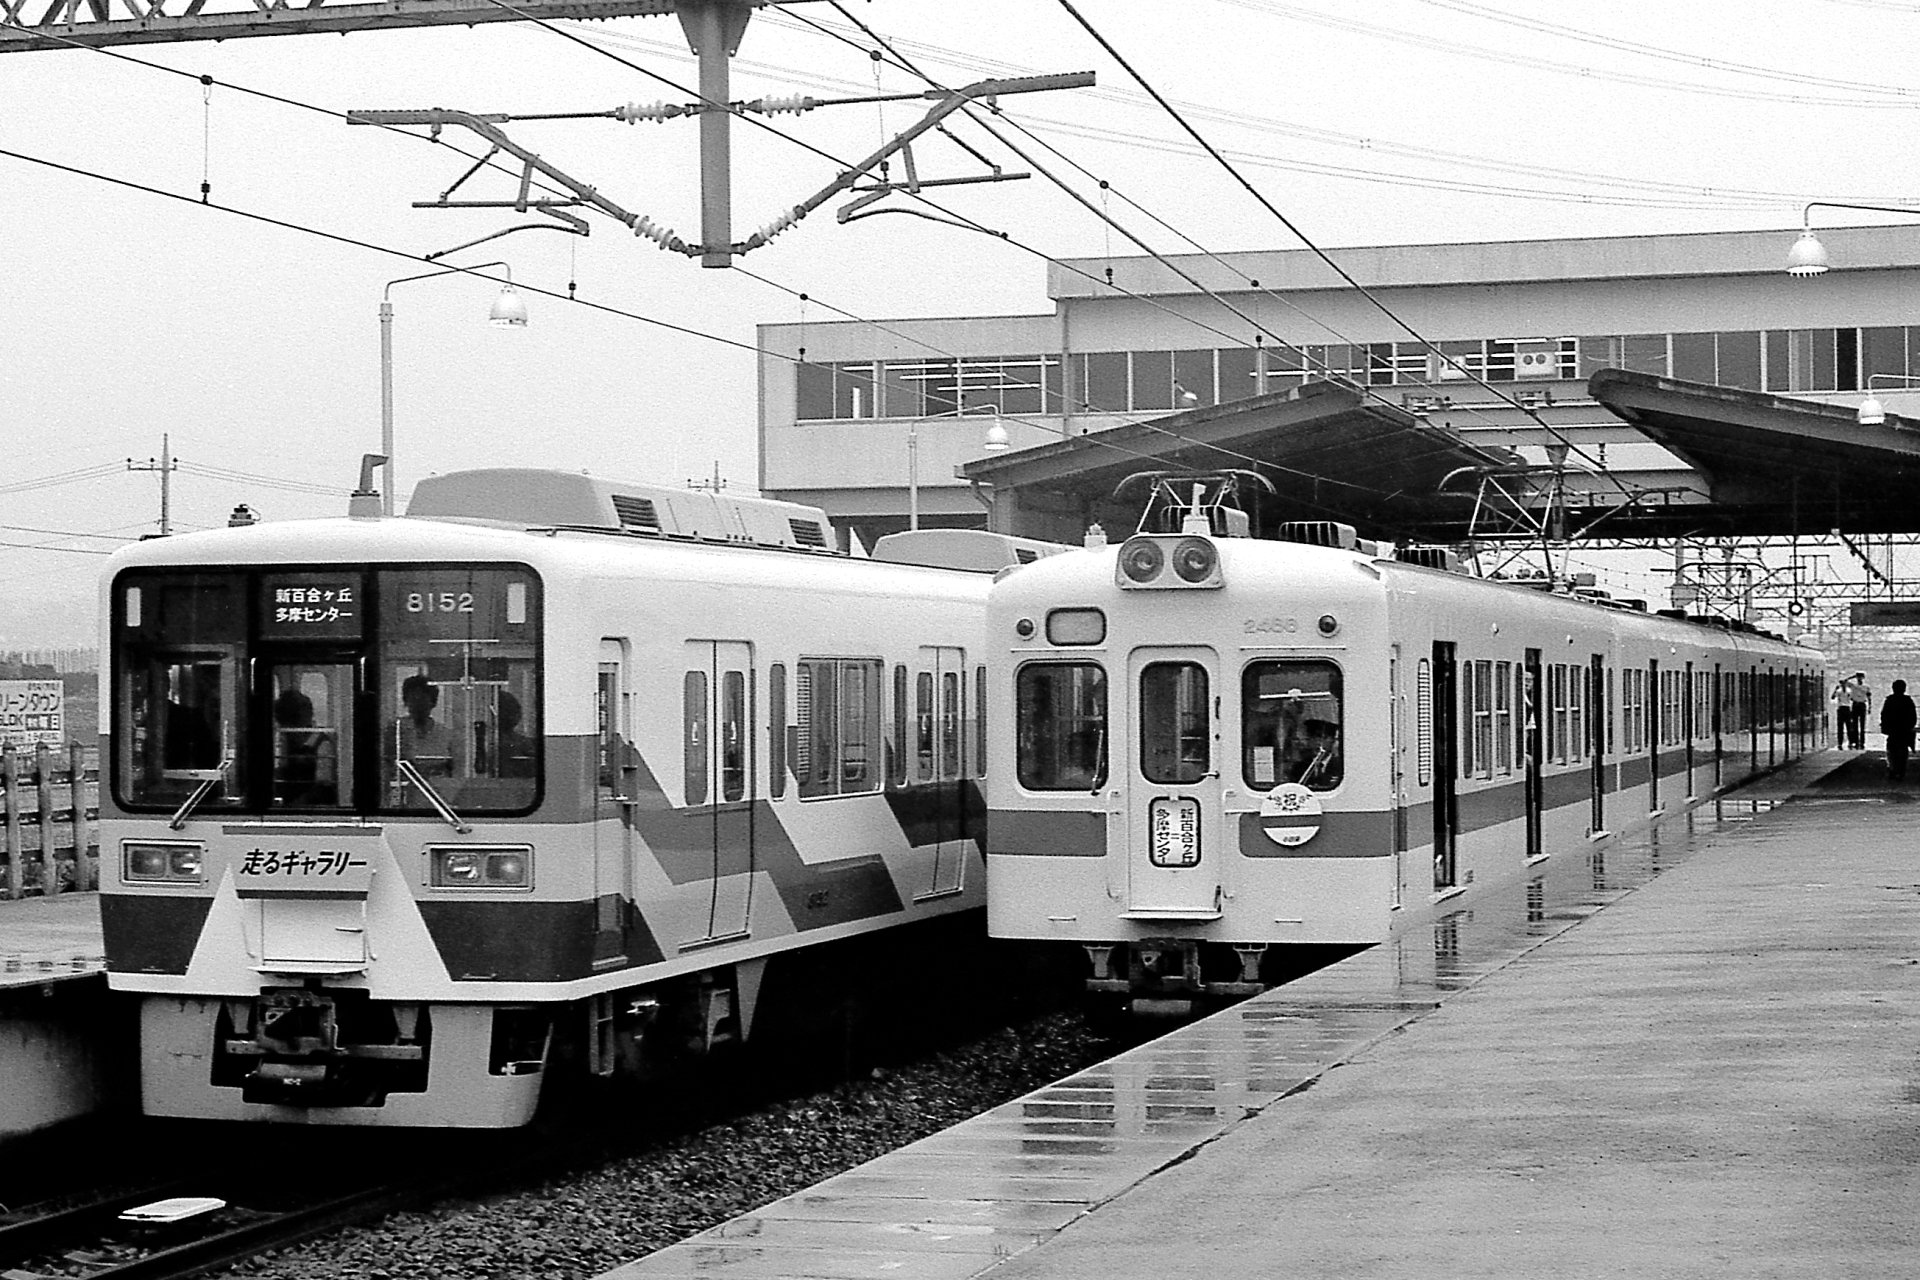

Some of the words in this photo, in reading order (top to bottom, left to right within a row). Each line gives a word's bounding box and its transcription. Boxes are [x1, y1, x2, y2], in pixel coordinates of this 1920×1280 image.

[275, 587, 353, 603] 新百合ヶ丘
[407, 592, 474, 612] 8152
[275, 607, 353, 622] 多摩センター
[239, 848, 367, 875] 走るギャラリー
